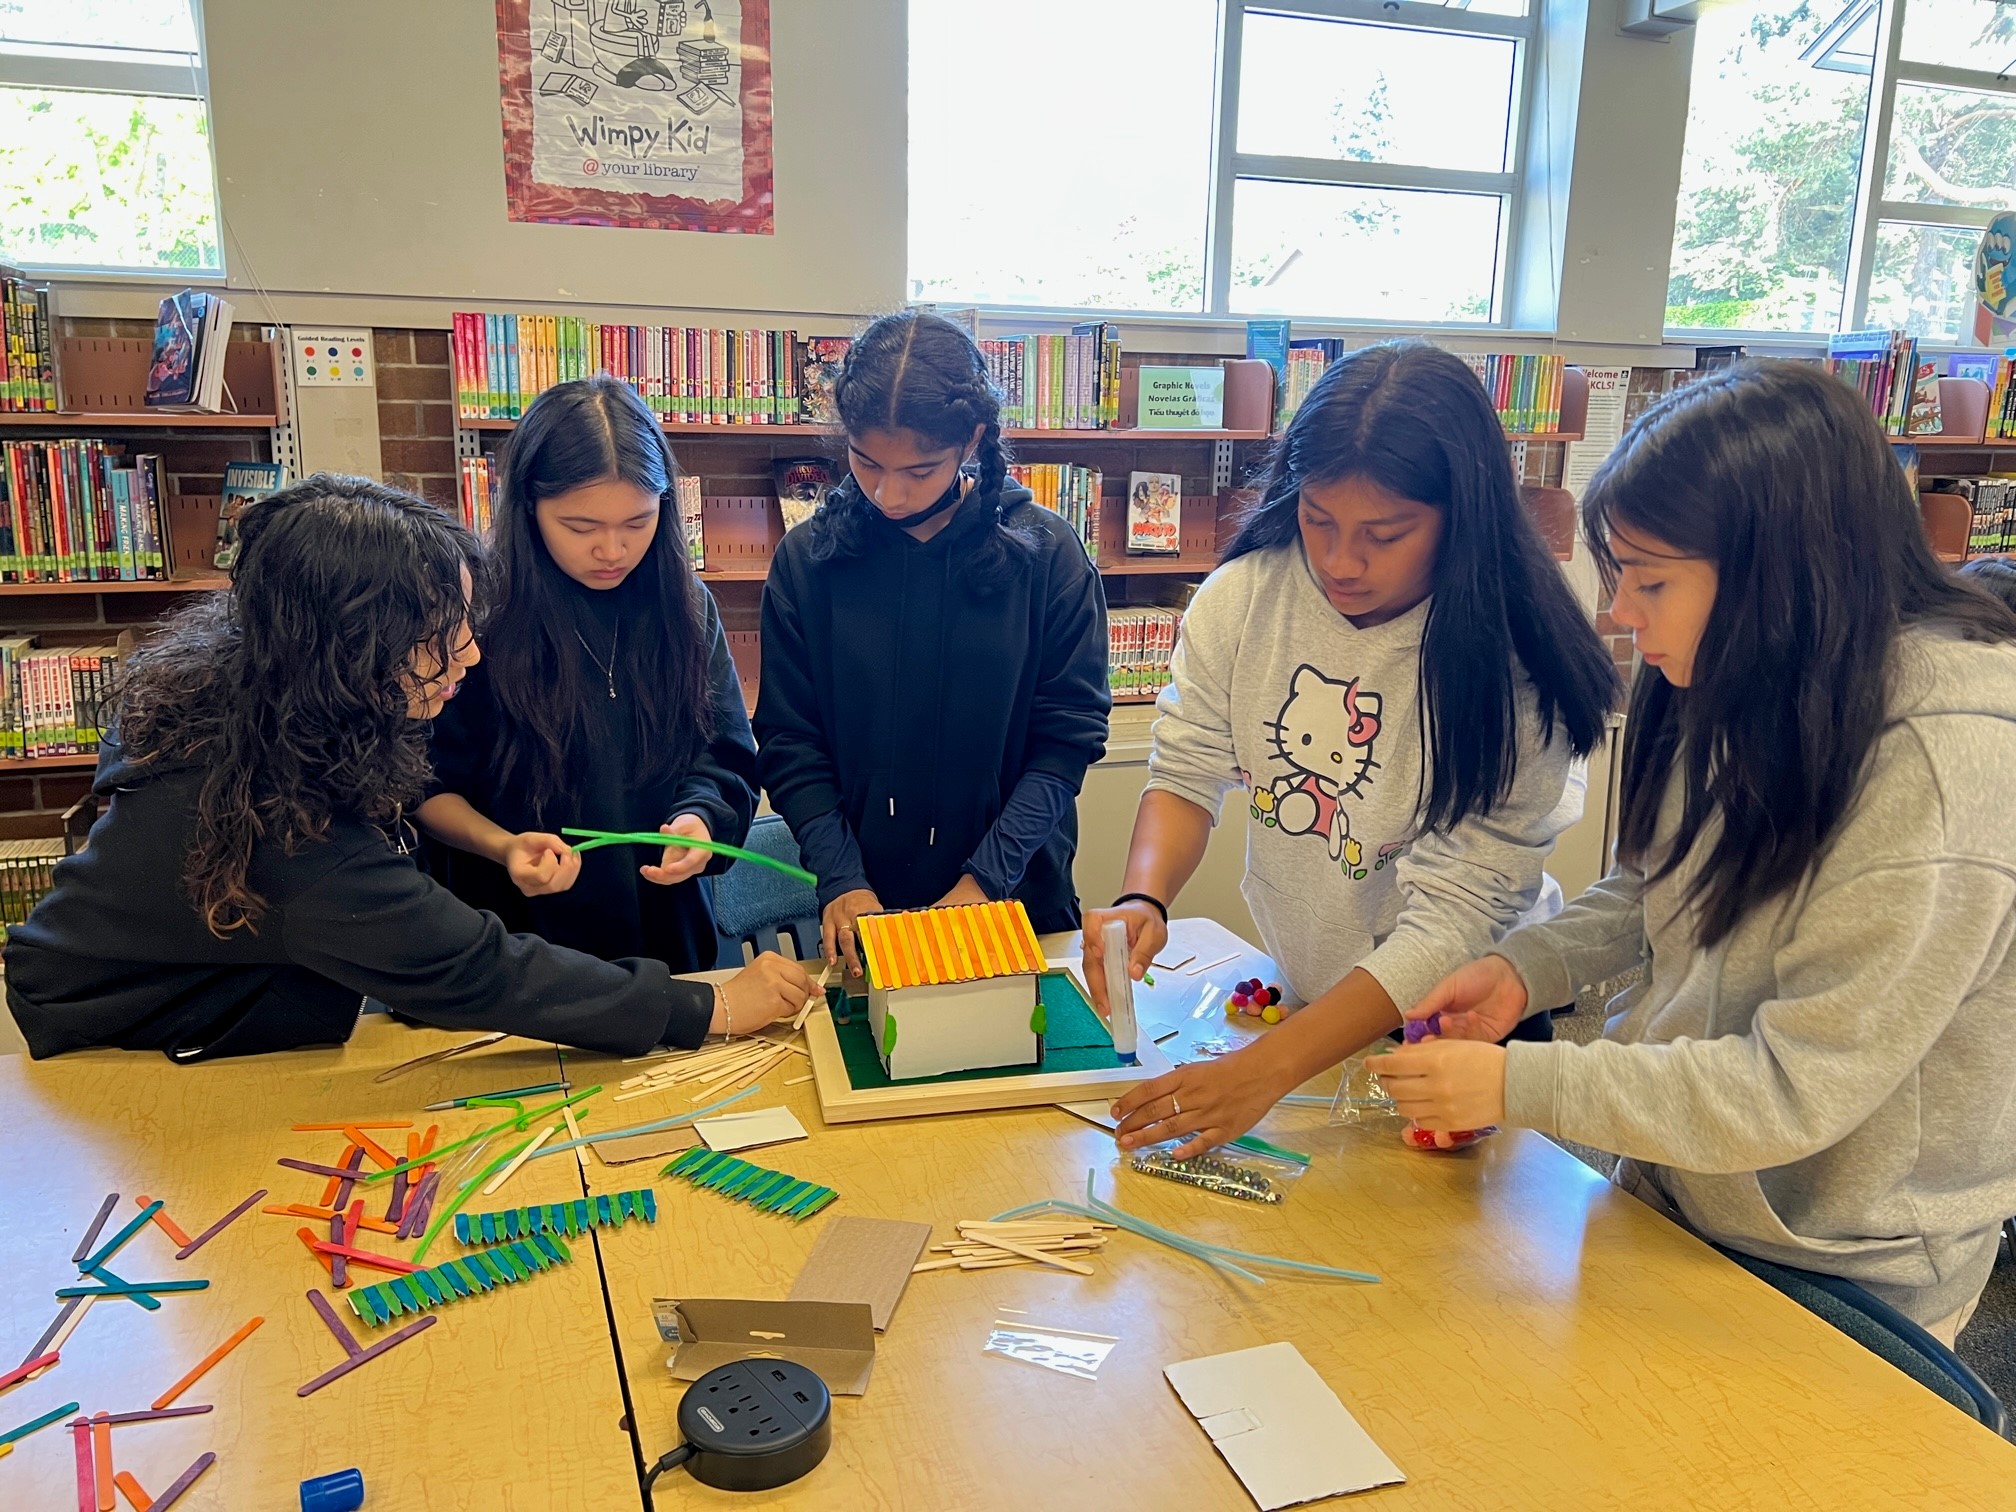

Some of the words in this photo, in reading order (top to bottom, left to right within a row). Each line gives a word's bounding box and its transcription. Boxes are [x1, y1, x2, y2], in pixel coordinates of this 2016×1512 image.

[566, 115, 660, 158] Wimpy
[668, 117, 709, 154] Kid
[583, 158, 599, 176] @
[601, 163, 640, 176] your
[643, 163, 698, 181] library
[1153, 381, 1183, 390] Graphic
[1184, 381, 1211, 390] Novels
[1590, 381, 1615, 390] KCLS!
[226, 468, 276, 489] INVISIBLE
